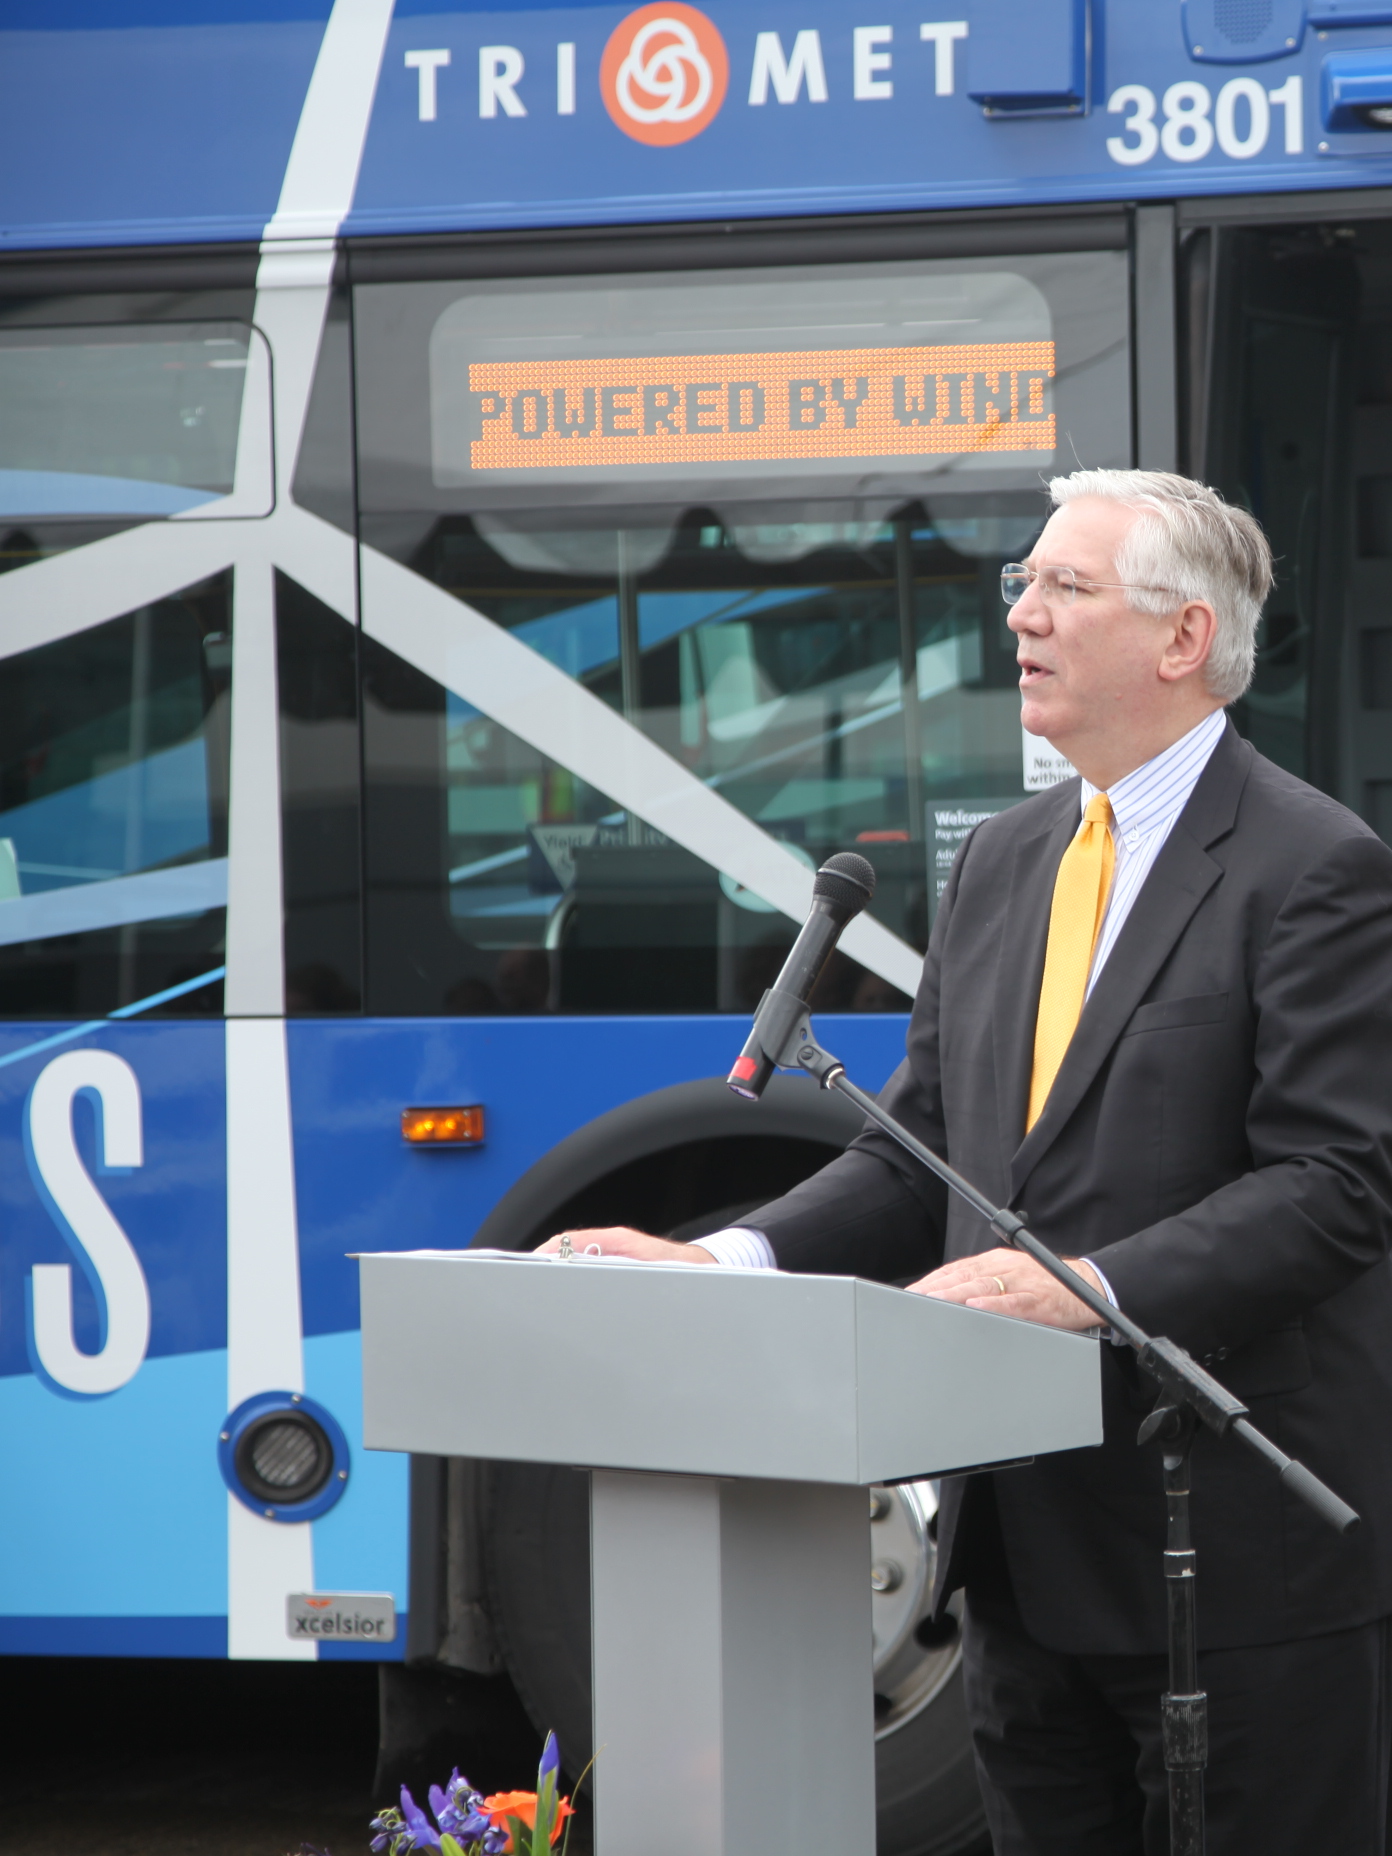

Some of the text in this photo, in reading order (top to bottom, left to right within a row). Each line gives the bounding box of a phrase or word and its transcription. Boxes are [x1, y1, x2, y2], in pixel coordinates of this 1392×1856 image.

[404, 20, 969, 121] TRI MET
[1105, 75, 1304, 166] 3801
[469, 370, 1056, 441] POWERED BY WIND
[1033, 757, 1052, 769] No
[601, 828, 667, 847] Priity
[935, 828, 953, 843] Pay
[935, 848, 958, 861] Adu
[295, 1611, 385, 1636] xcelsior
